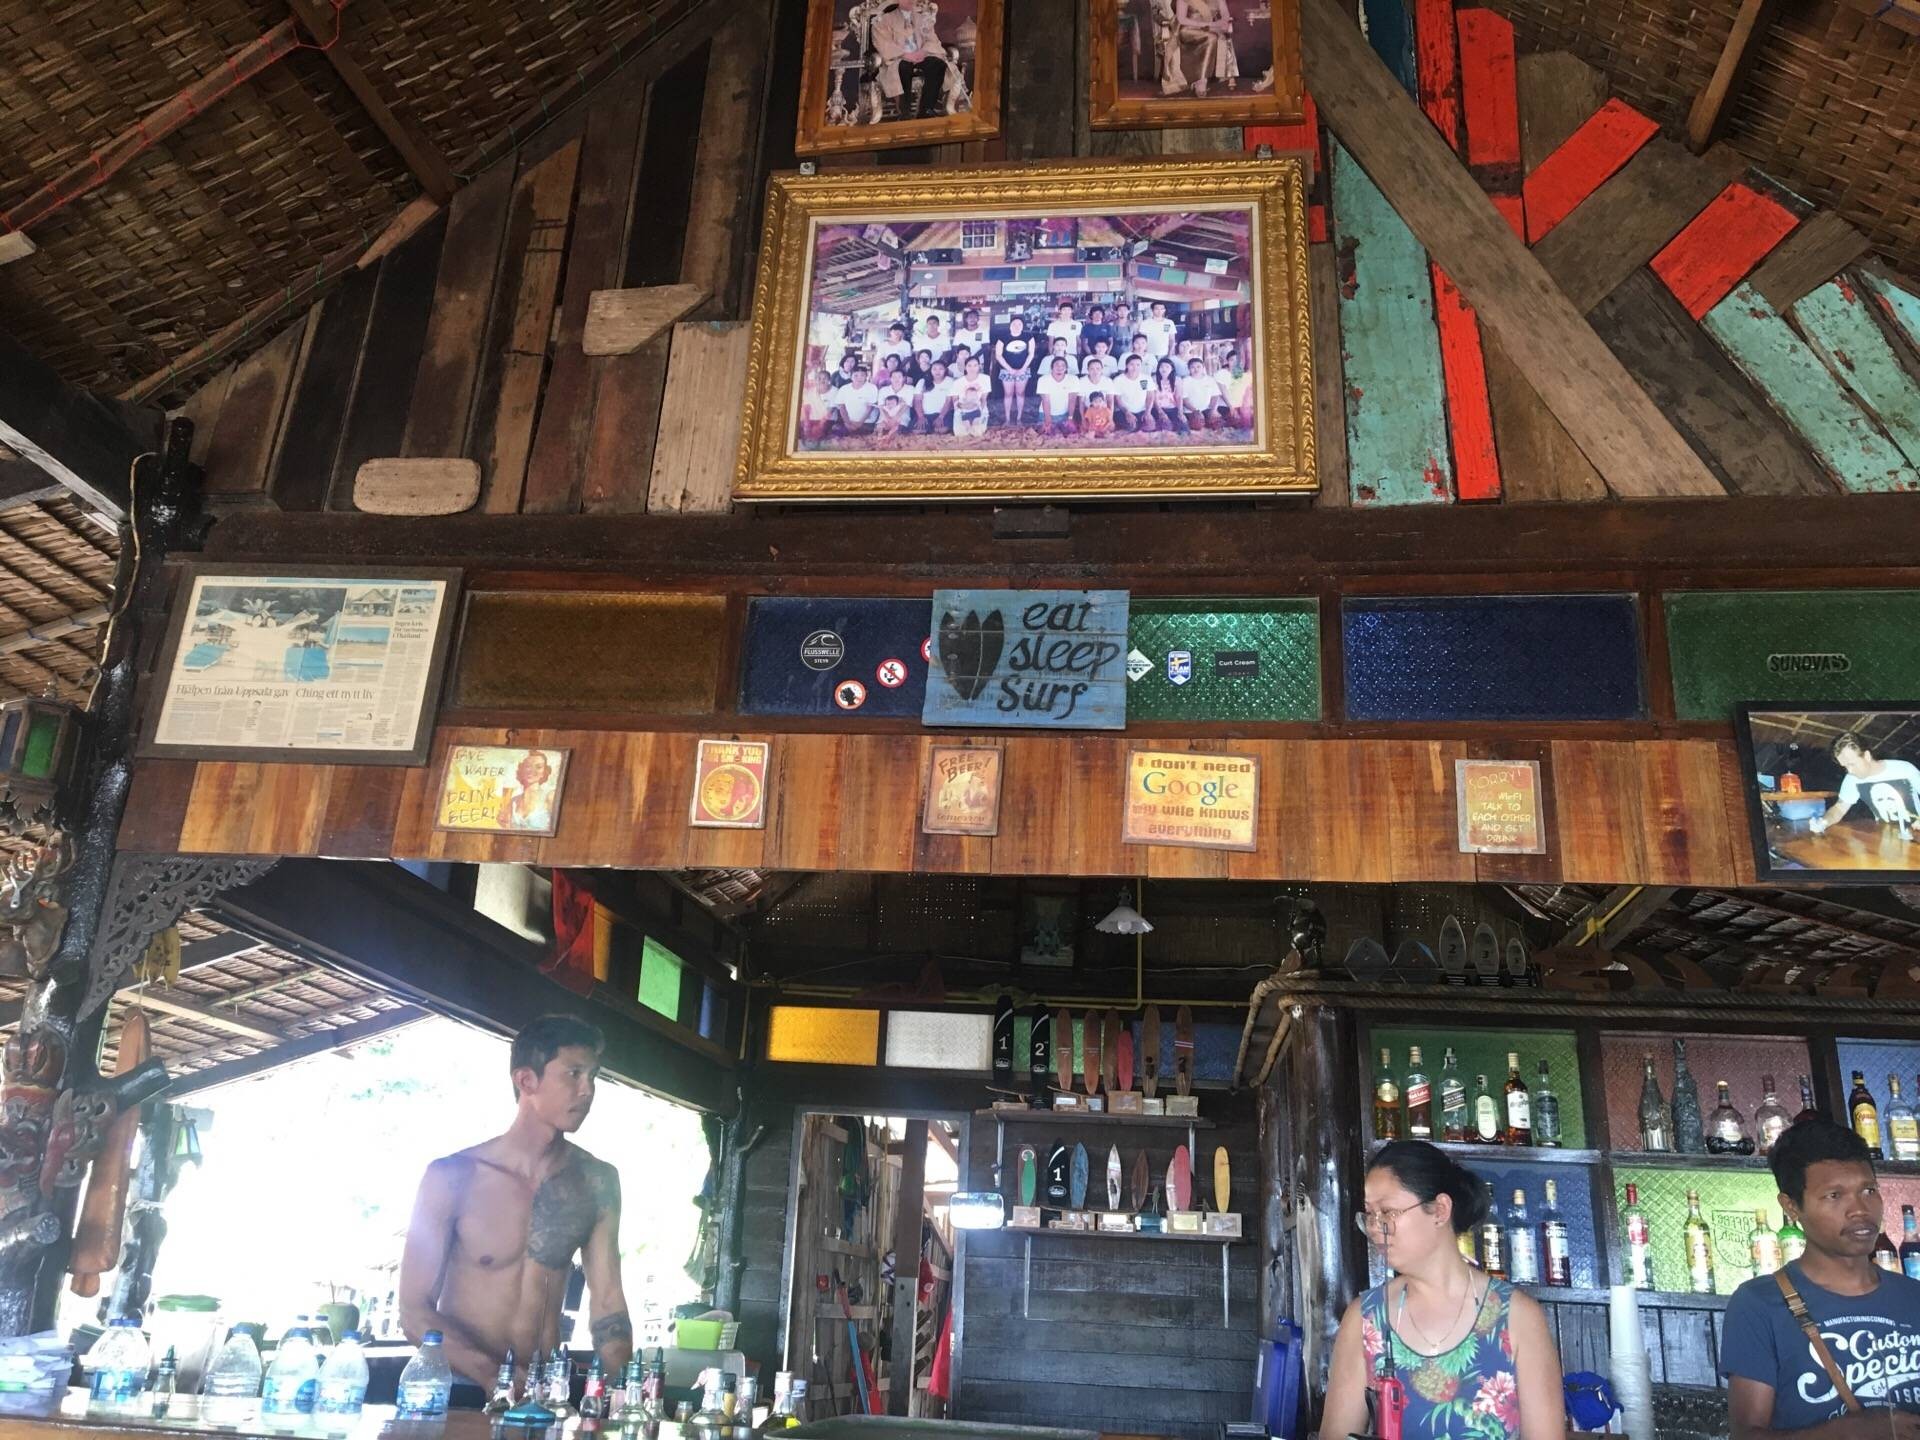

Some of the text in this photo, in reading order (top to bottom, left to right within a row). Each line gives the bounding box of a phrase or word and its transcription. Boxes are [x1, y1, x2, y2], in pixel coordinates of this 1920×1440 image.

[1022, 602, 1092, 632] eat
[1008, 631, 1120, 682] sleep
[455, 748, 485, 761] SAVE
[464, 765, 505, 777] WATER
[938, 752, 975, 776] FREE
[946, 757, 992, 783] BEER!
[1150, 758, 1197, 770] don't
[1203, 762, 1251, 773] need
[447, 787, 496, 806] DRINK
[1142, 771, 1239, 806] Google
[448, 806, 496, 824] BEER!
[1162, 805, 1194, 818] wife
[1199, 806, 1250, 821] knows
[1481, 802, 1521, 812] TALK TO
[1472, 812, 1531, 823] EACH OTHER
[1148, 823, 1232, 840] everything
[1481, 823, 1523, 833] AND GET
[1486, 834, 1518, 843] DRUNK
